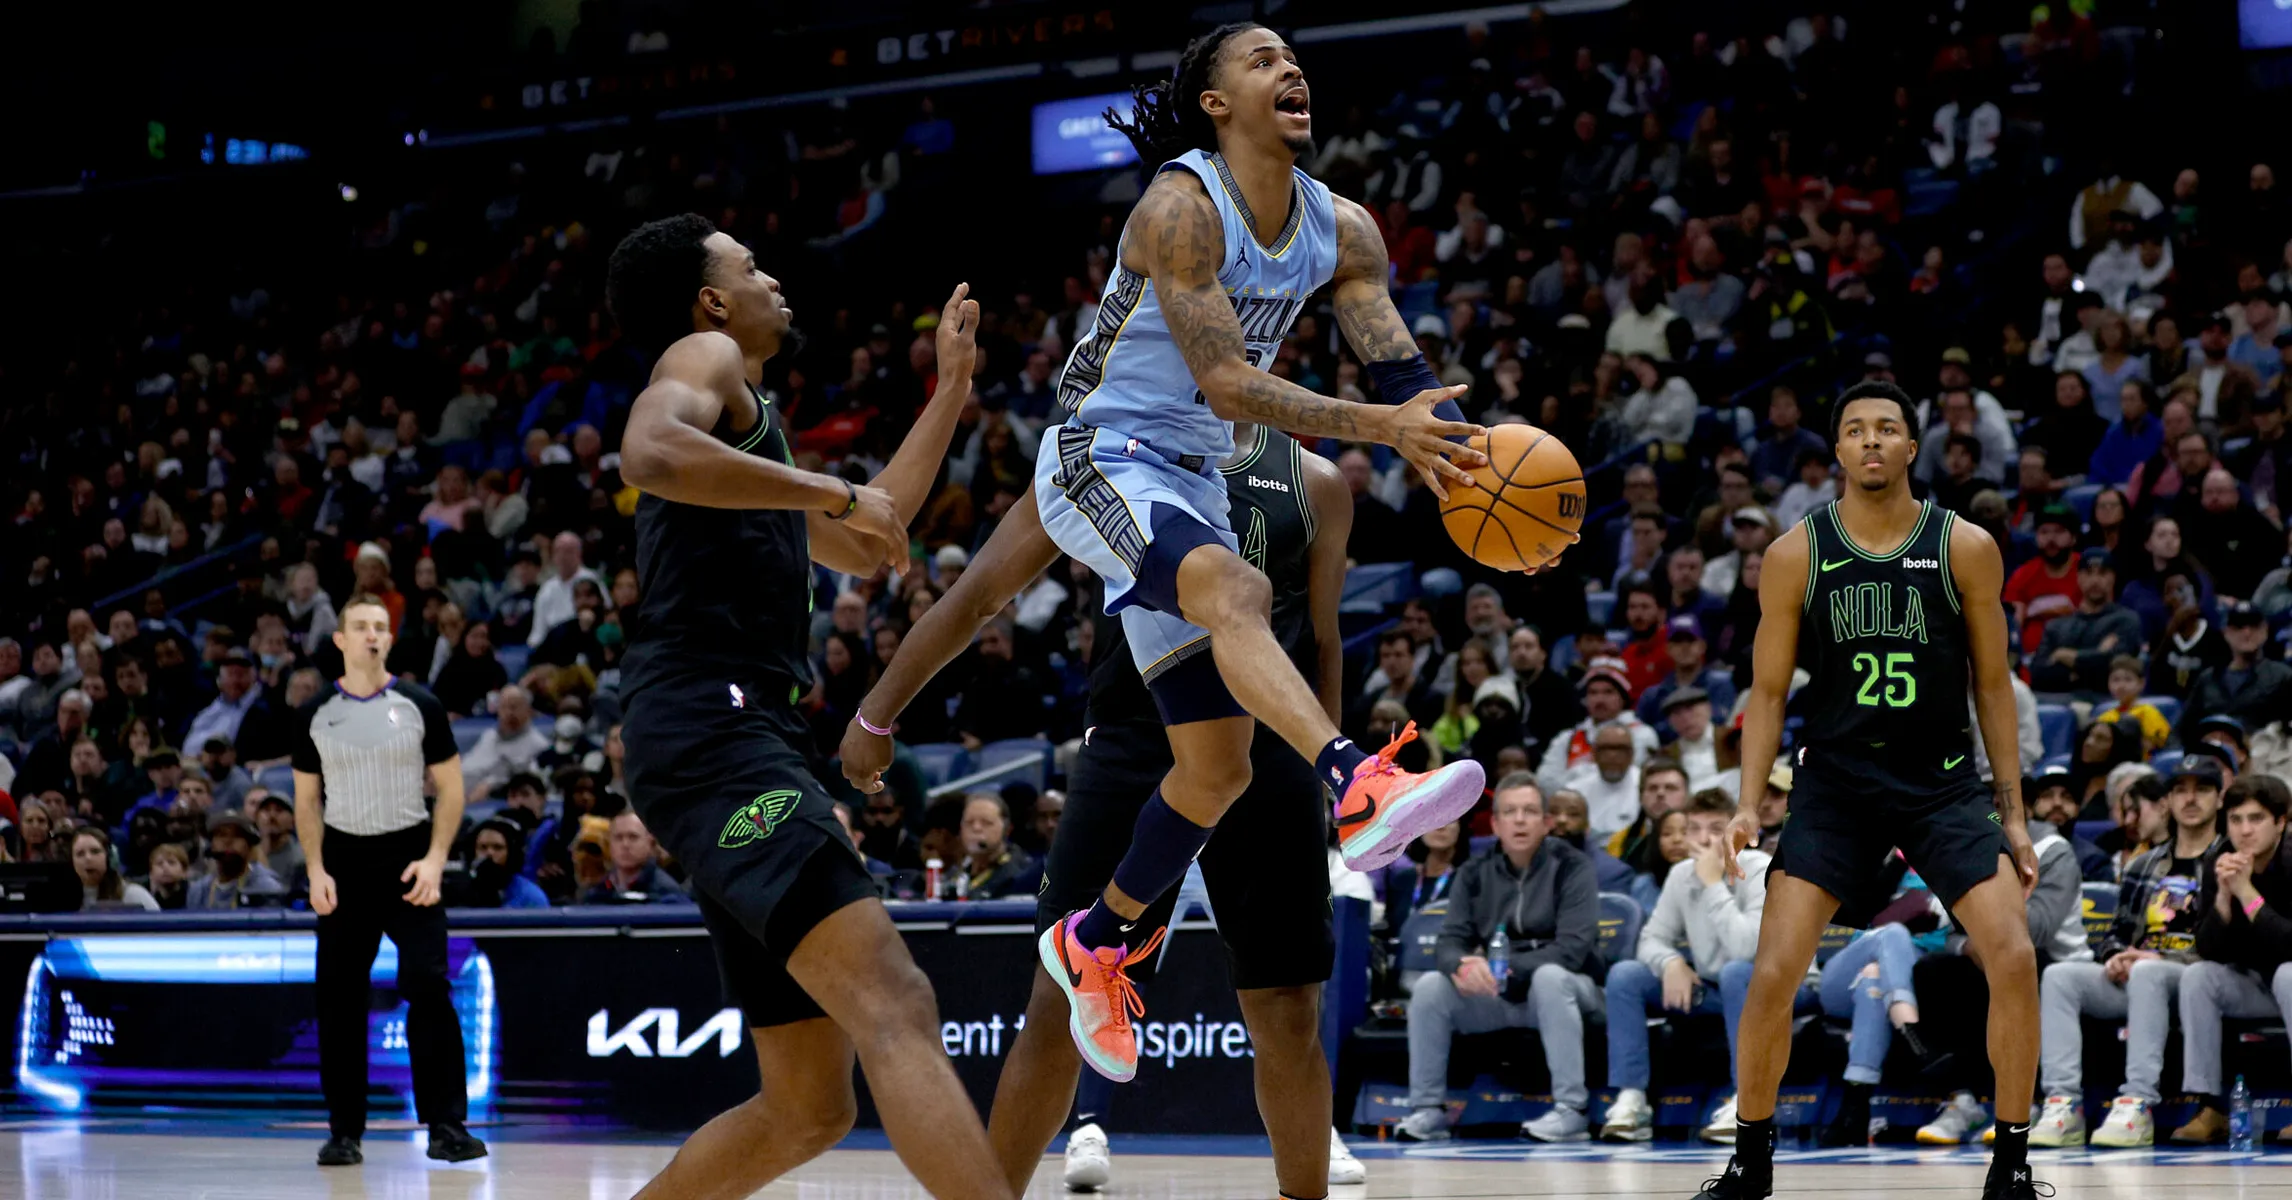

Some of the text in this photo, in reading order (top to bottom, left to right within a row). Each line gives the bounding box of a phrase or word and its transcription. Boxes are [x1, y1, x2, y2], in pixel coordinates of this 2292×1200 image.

[1226, 286, 1298, 297] MEMPHI
[1248, 475, 1289, 493] ibotta
[1902, 557, 1938, 569] ibotta
[1830, 581, 1929, 644] NOLA
[1852, 652, 1917, 708] 25
[586, 1006, 743, 1059] KIA
[941, 1012, 1005, 1057] ent
